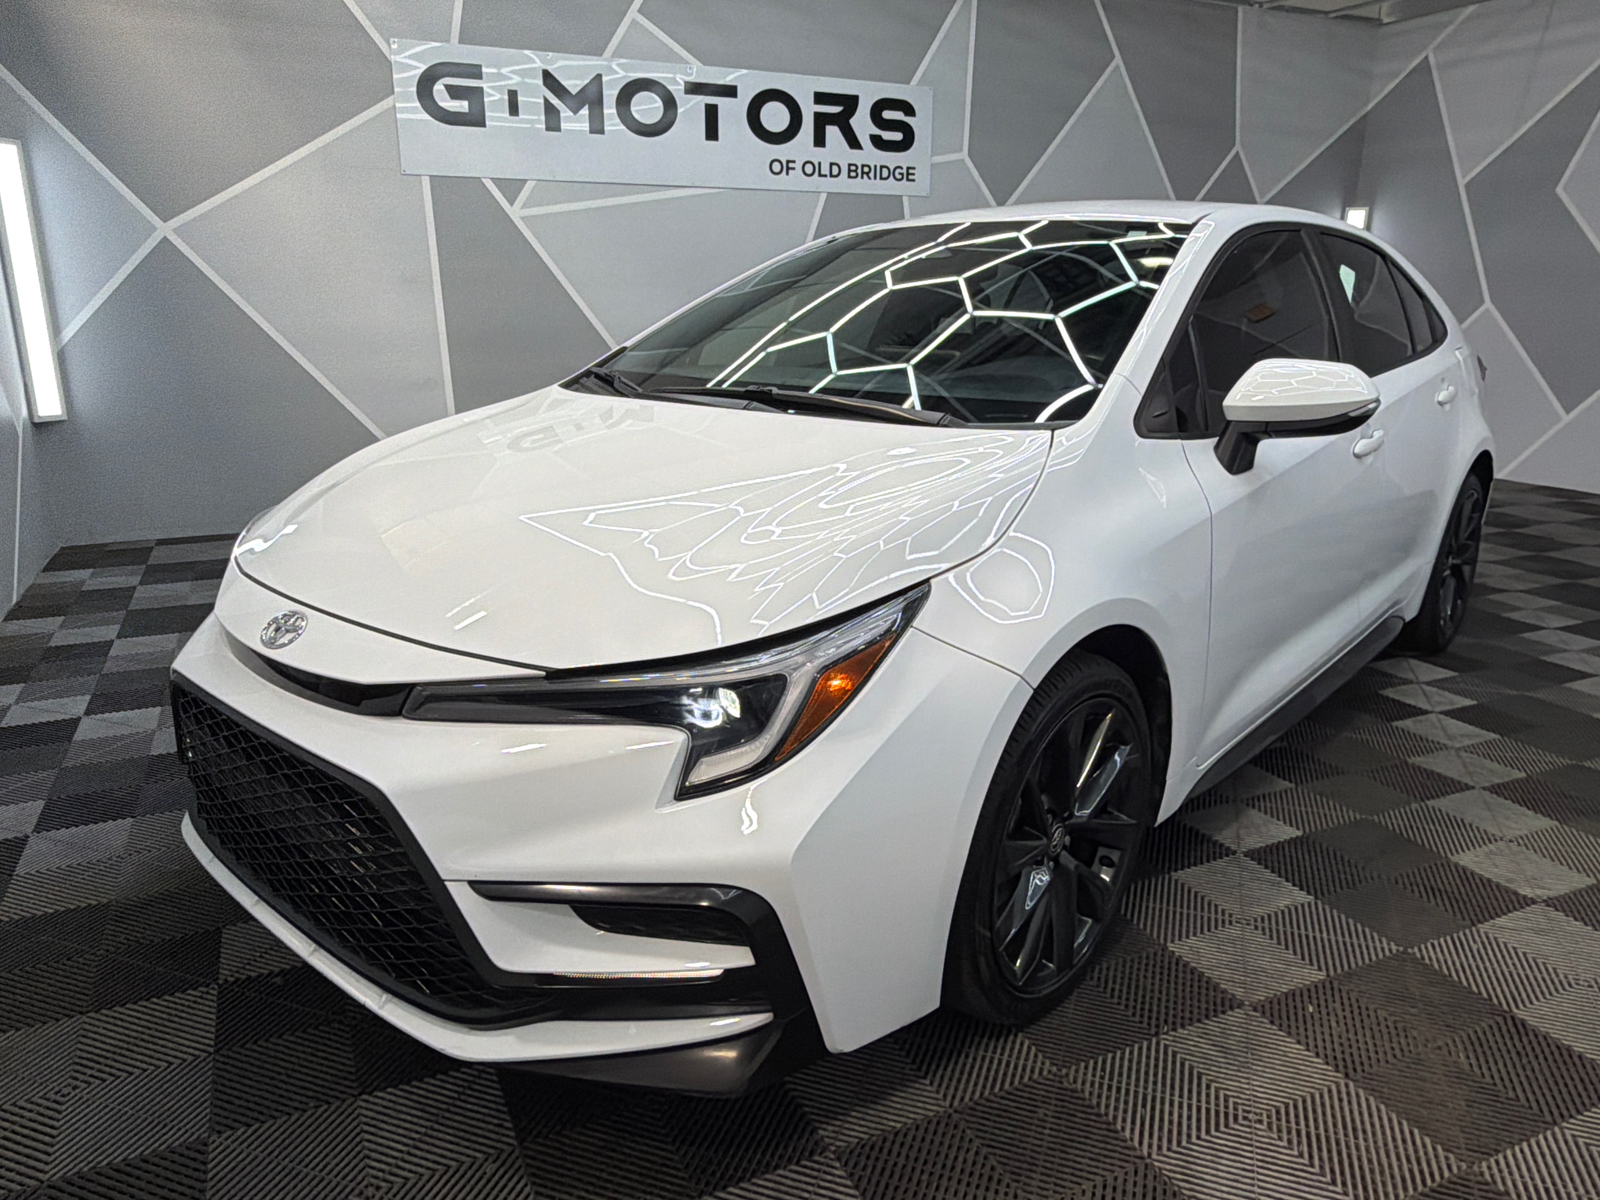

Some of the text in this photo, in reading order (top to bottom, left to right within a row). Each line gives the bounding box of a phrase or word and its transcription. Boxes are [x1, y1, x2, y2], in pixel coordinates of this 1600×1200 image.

[769, 158, 917, 183] OF OLD BRIDGE
